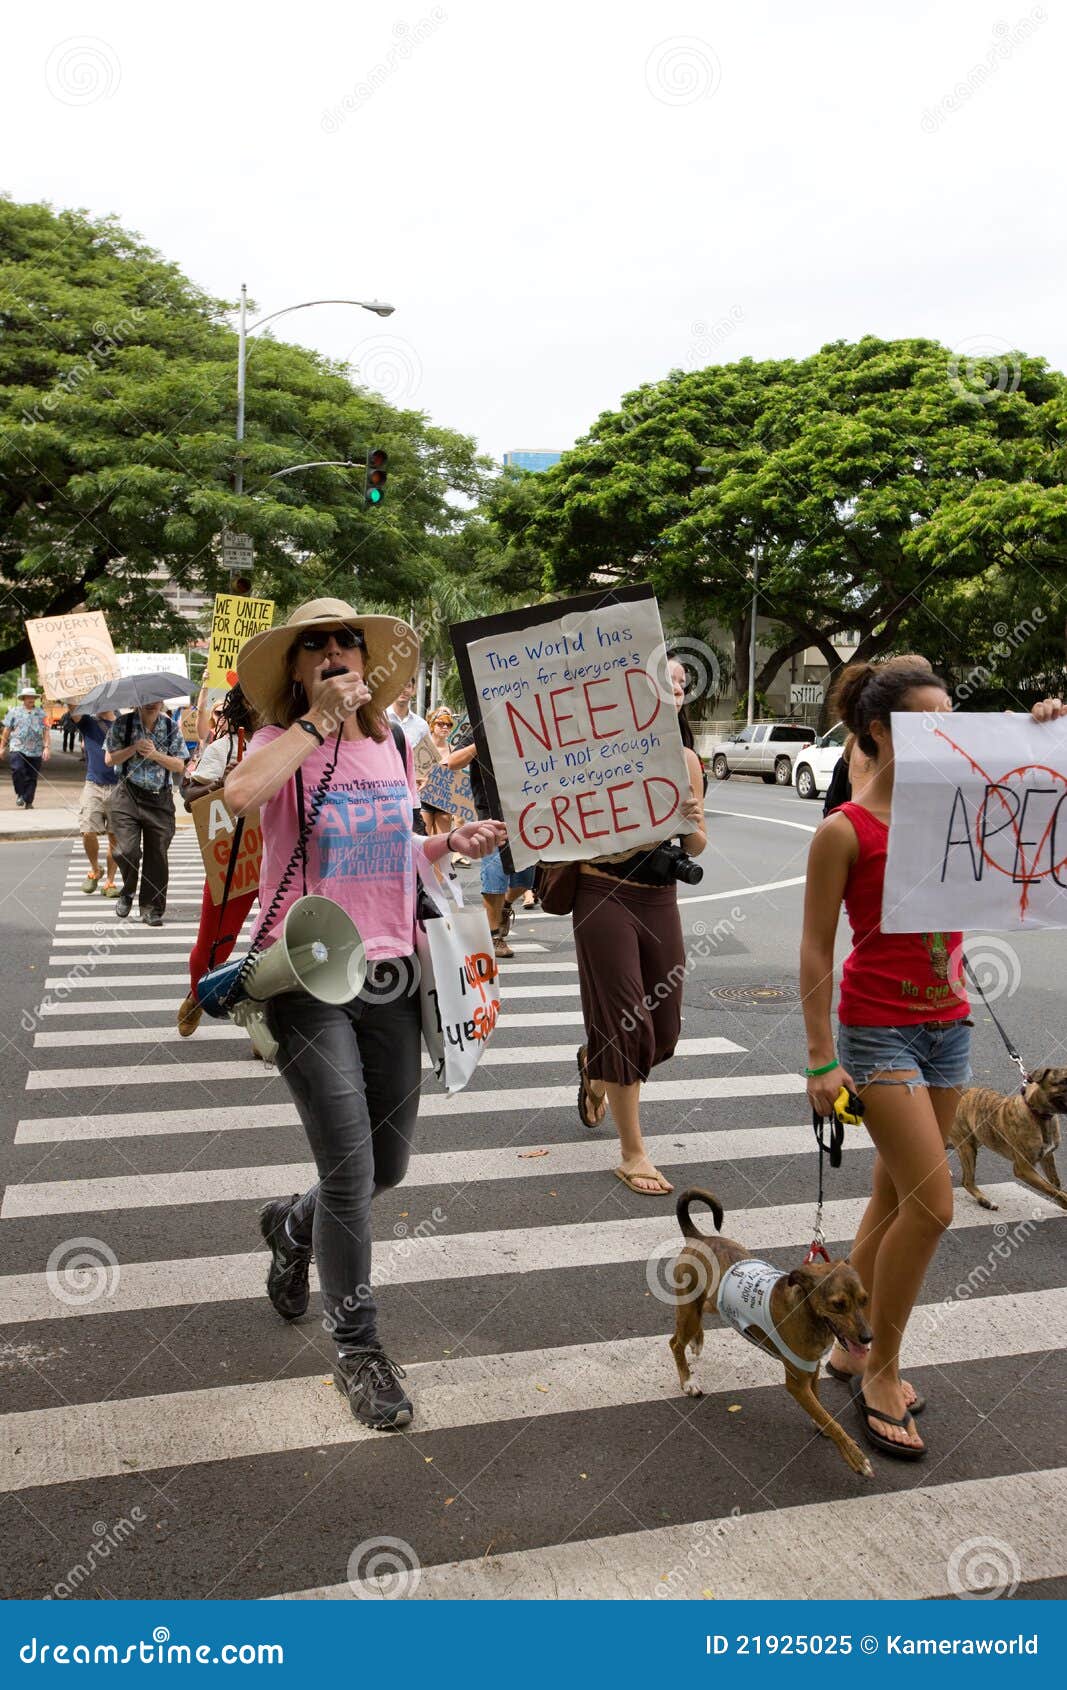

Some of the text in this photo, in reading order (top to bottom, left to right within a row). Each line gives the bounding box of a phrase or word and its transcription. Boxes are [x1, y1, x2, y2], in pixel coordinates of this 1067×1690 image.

[216, 598, 271, 620] WE UNITE
[213, 616, 229, 633] FOR
[40, 647, 88, 661] WORST
[213, 636, 240, 654] WITH
[486, 626, 633, 672] The World has
[59, 655, 99, 670] FORM
[217, 654, 234, 669] IN
[482, 651, 641, 701] enough for everyone's
[505, 668, 661, 758] NEED
[524, 732, 661, 777] But not enough
[521, 759, 645, 796] for everyone's
[518, 776, 680, 850] GREED
